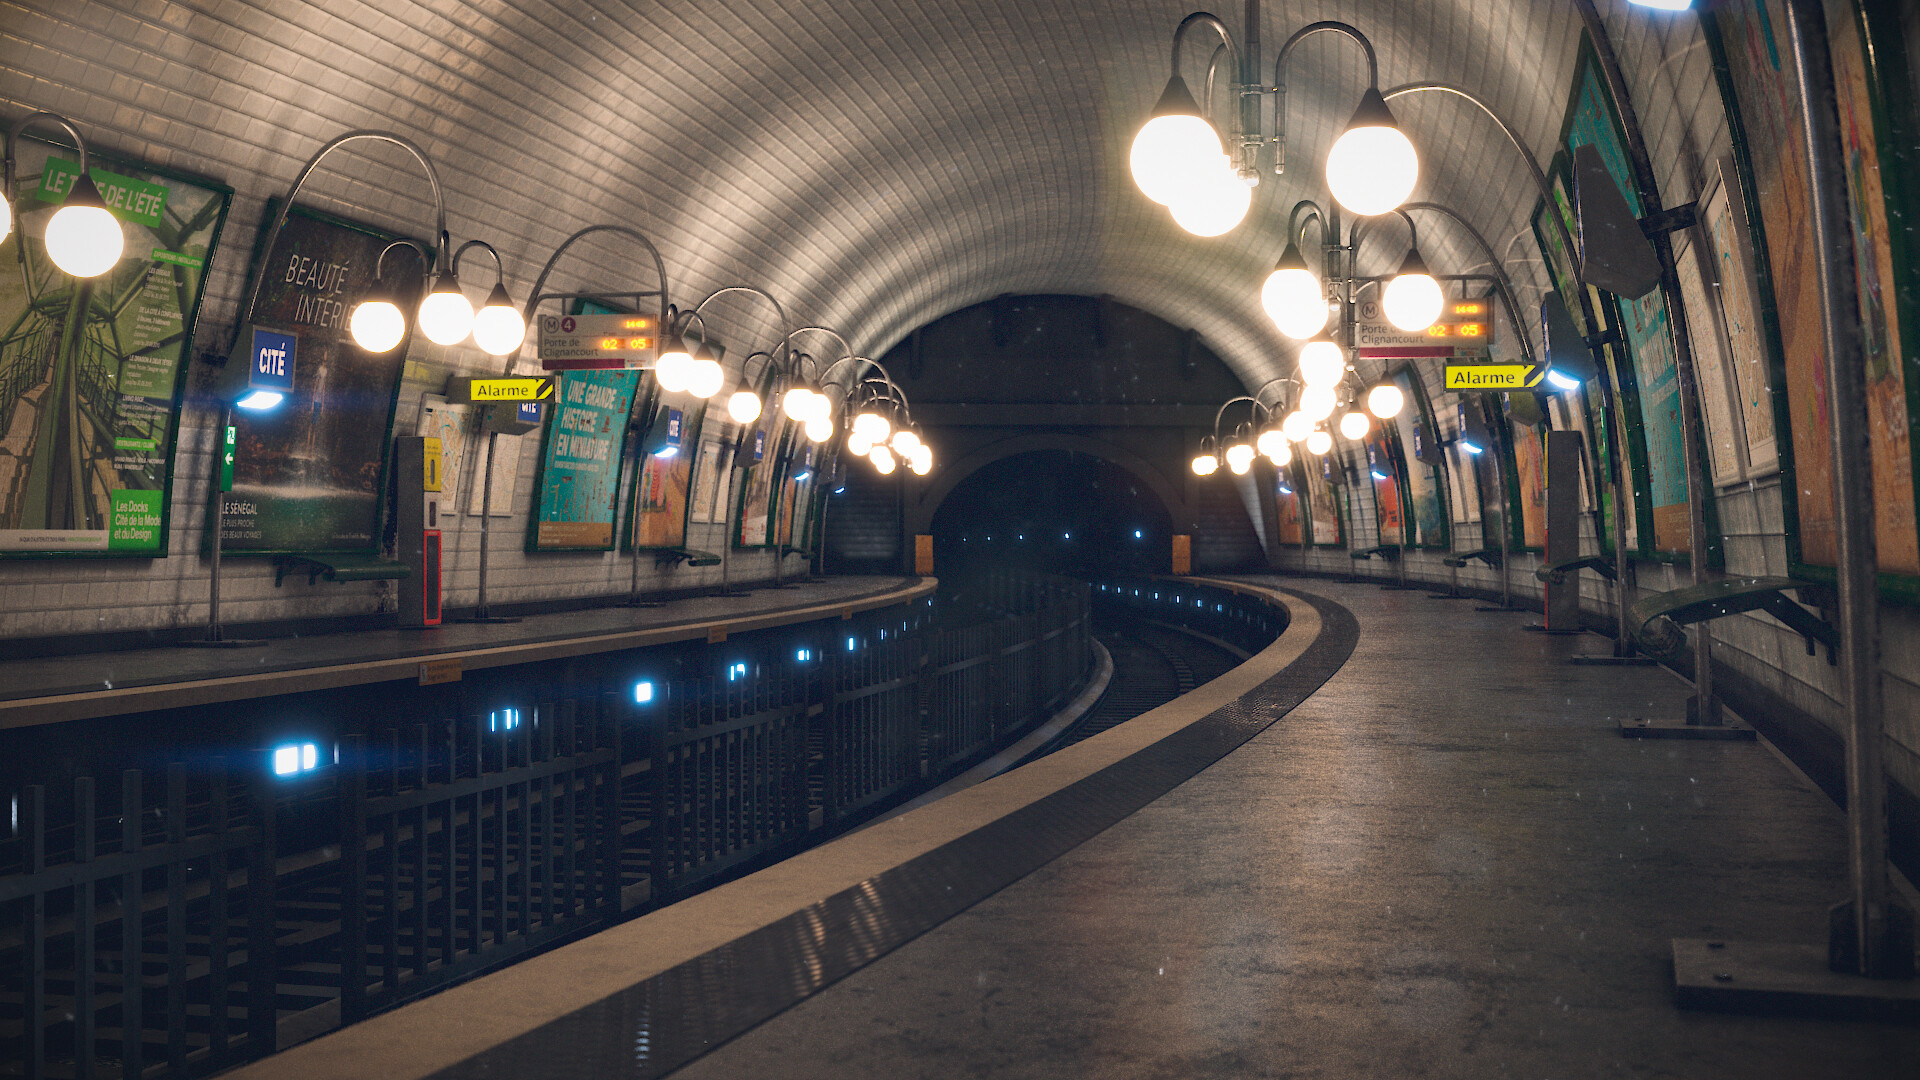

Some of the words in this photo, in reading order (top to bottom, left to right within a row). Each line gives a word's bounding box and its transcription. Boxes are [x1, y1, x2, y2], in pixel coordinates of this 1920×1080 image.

[45, 169, 66, 194] LE
[106, 185, 126, 208] DE
[126, 188, 162, 217] L'ÉTÉ
[286, 254, 350, 294] BEAUTÉ
[295, 293, 357, 331] INTÉRIE
[1362, 325, 1387, 334] Porte
[1428, 325, 1446, 336] 02
[1461, 325, 1478, 336] 05
[544, 338, 567, 347] Porte
[570, 338, 580, 347] de
[602, 340, 617, 349] 02
[631, 339, 646, 350] 05
[1362, 335, 1424, 345] Clignancourt
[259, 342, 286, 376] CITÉ
[544, 349, 598, 358] Clignancourt
[1454, 372, 1514, 384] Alarme
[478, 385, 528, 397] Alarme
[568, 380, 586, 404] UNE
[585, 384, 617, 410] GRANDE
[561, 407, 598, 432] HISTOIRE
[556, 434, 570, 456] EN
[569, 436, 609, 461] MINIATURE
[116, 500, 128, 512] Les
[129, 501, 149, 512] Docks
[222, 503, 229, 514] LE
[230, 500, 258, 515] SÉNÉGAL
[115, 514, 128, 526] Cité
[129, 514, 137, 525] de
[138, 514, 143, 525] la
[144, 514, 161, 526] Mode
[114, 528, 121, 539] et
[122, 528, 130, 539] du
[131, 528, 152, 542] Design
